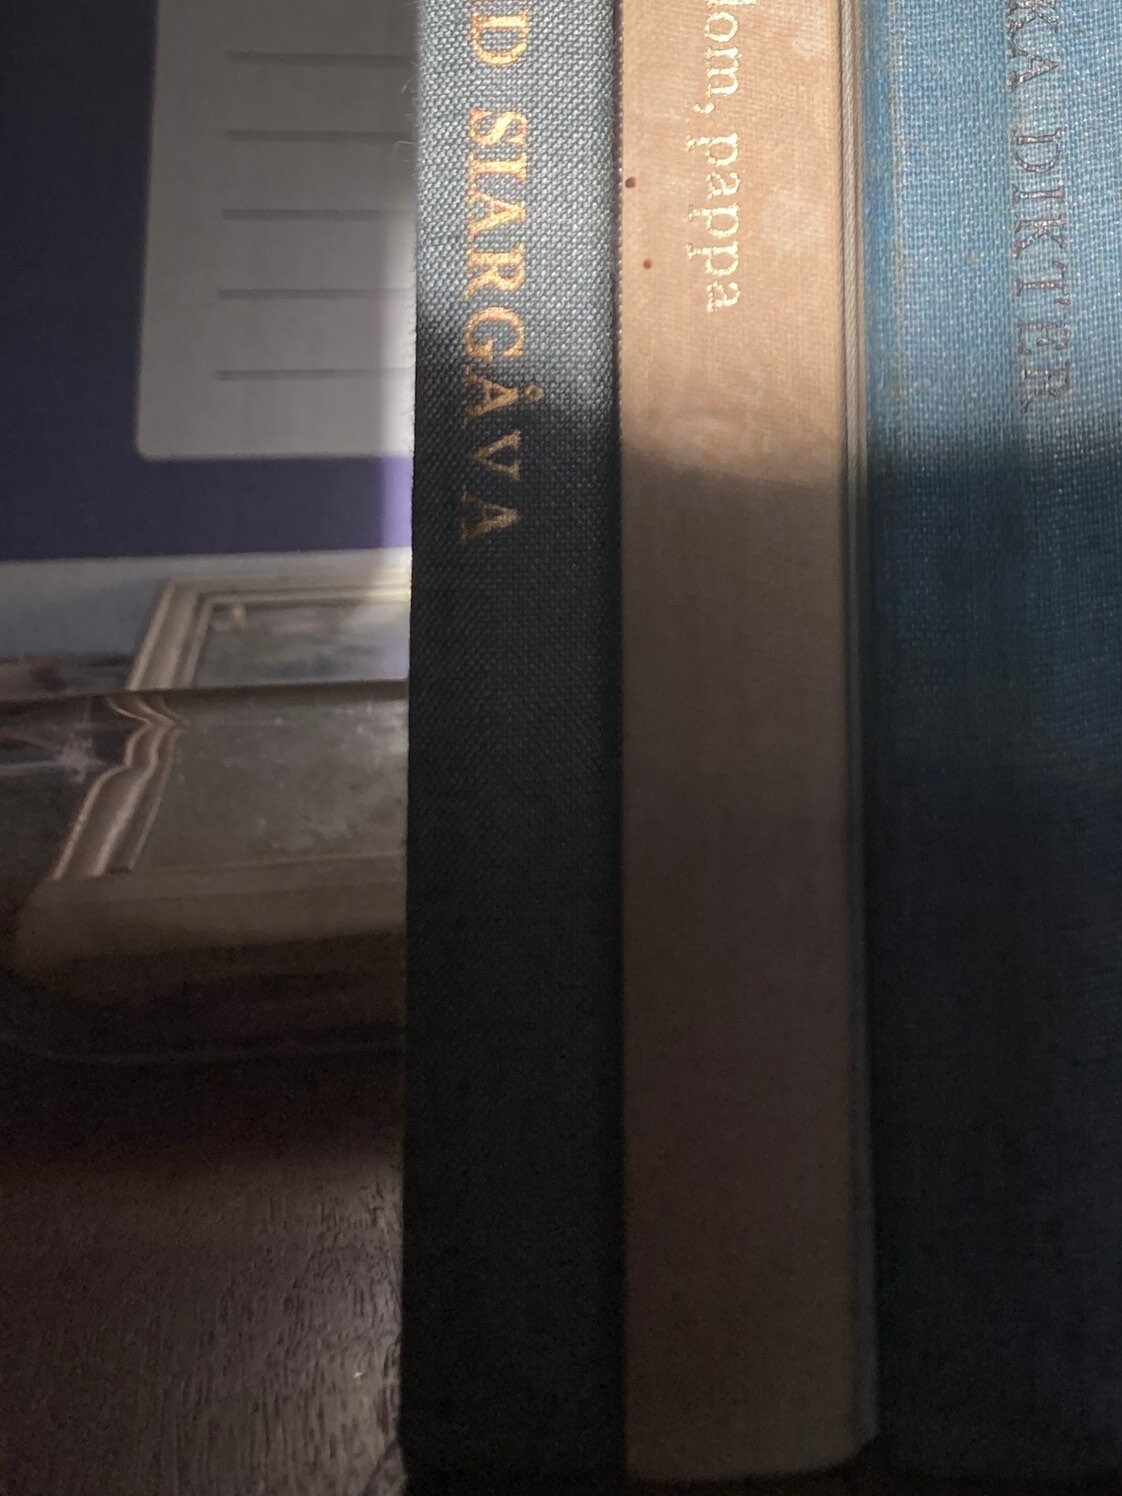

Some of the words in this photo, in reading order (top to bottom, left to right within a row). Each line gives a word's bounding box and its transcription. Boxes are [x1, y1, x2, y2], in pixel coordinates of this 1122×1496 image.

[458, 107, 544, 546] SIARGÅVA
[686, 131, 742, 313] pappa
[1011, 127, 1073, 415] DIKTER
